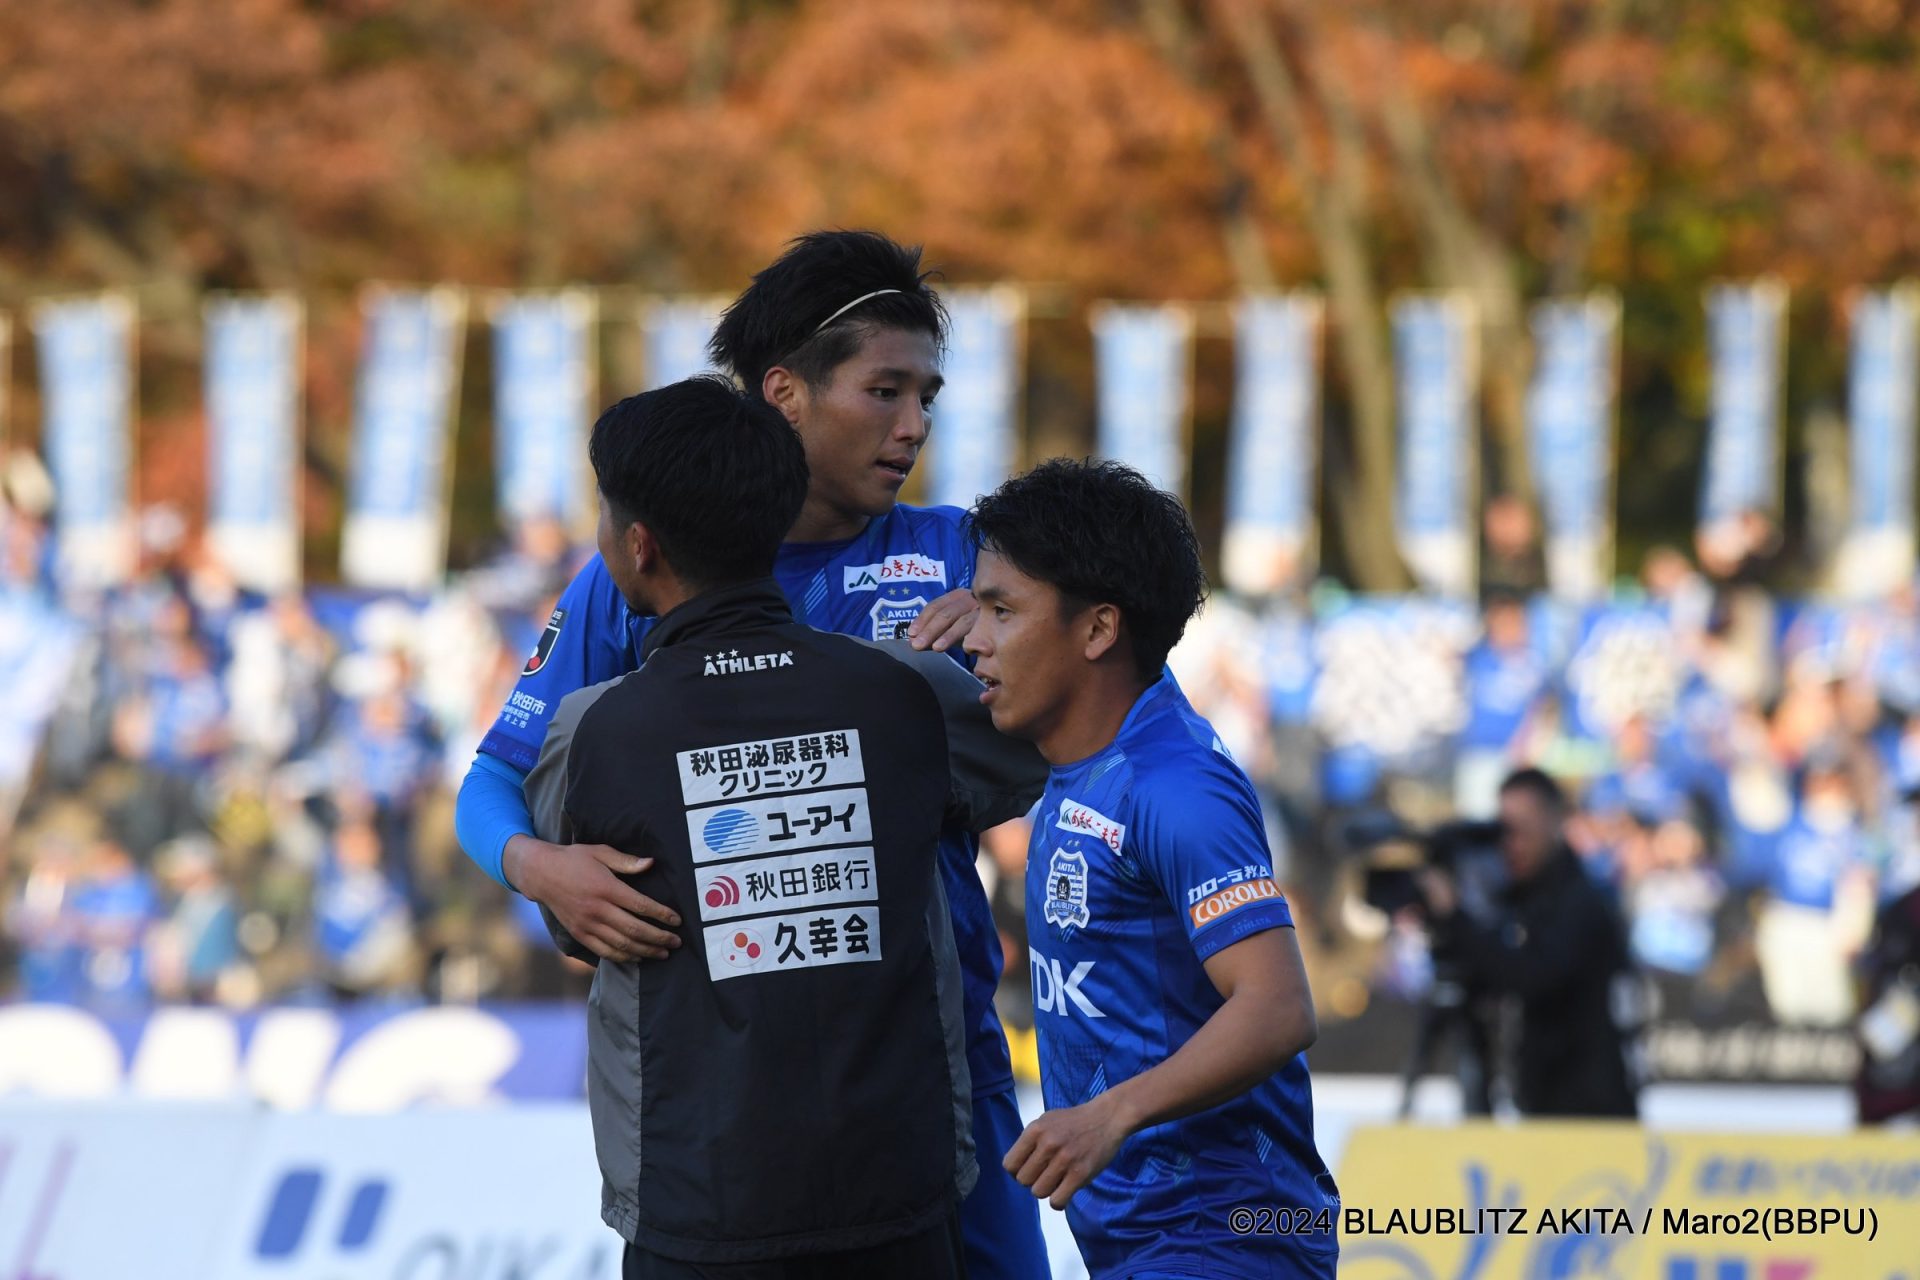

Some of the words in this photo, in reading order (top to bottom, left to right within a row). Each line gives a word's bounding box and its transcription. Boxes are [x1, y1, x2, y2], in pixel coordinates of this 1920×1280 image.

[887, 609, 919, 618] AKITA
[703, 652, 794, 676] ATHLETA
[511, 690, 546, 715] 秋田市
[690, 732, 850, 777] 秋田泌尿器科
[719, 762, 827, 797] クリニック
[766, 803, 856, 842] ユーアイ
[745, 859, 870, 902] 秋田銀行
[1057, 862, 1076, 873] AKITA
[774, 913, 870, 964] 久幸会
